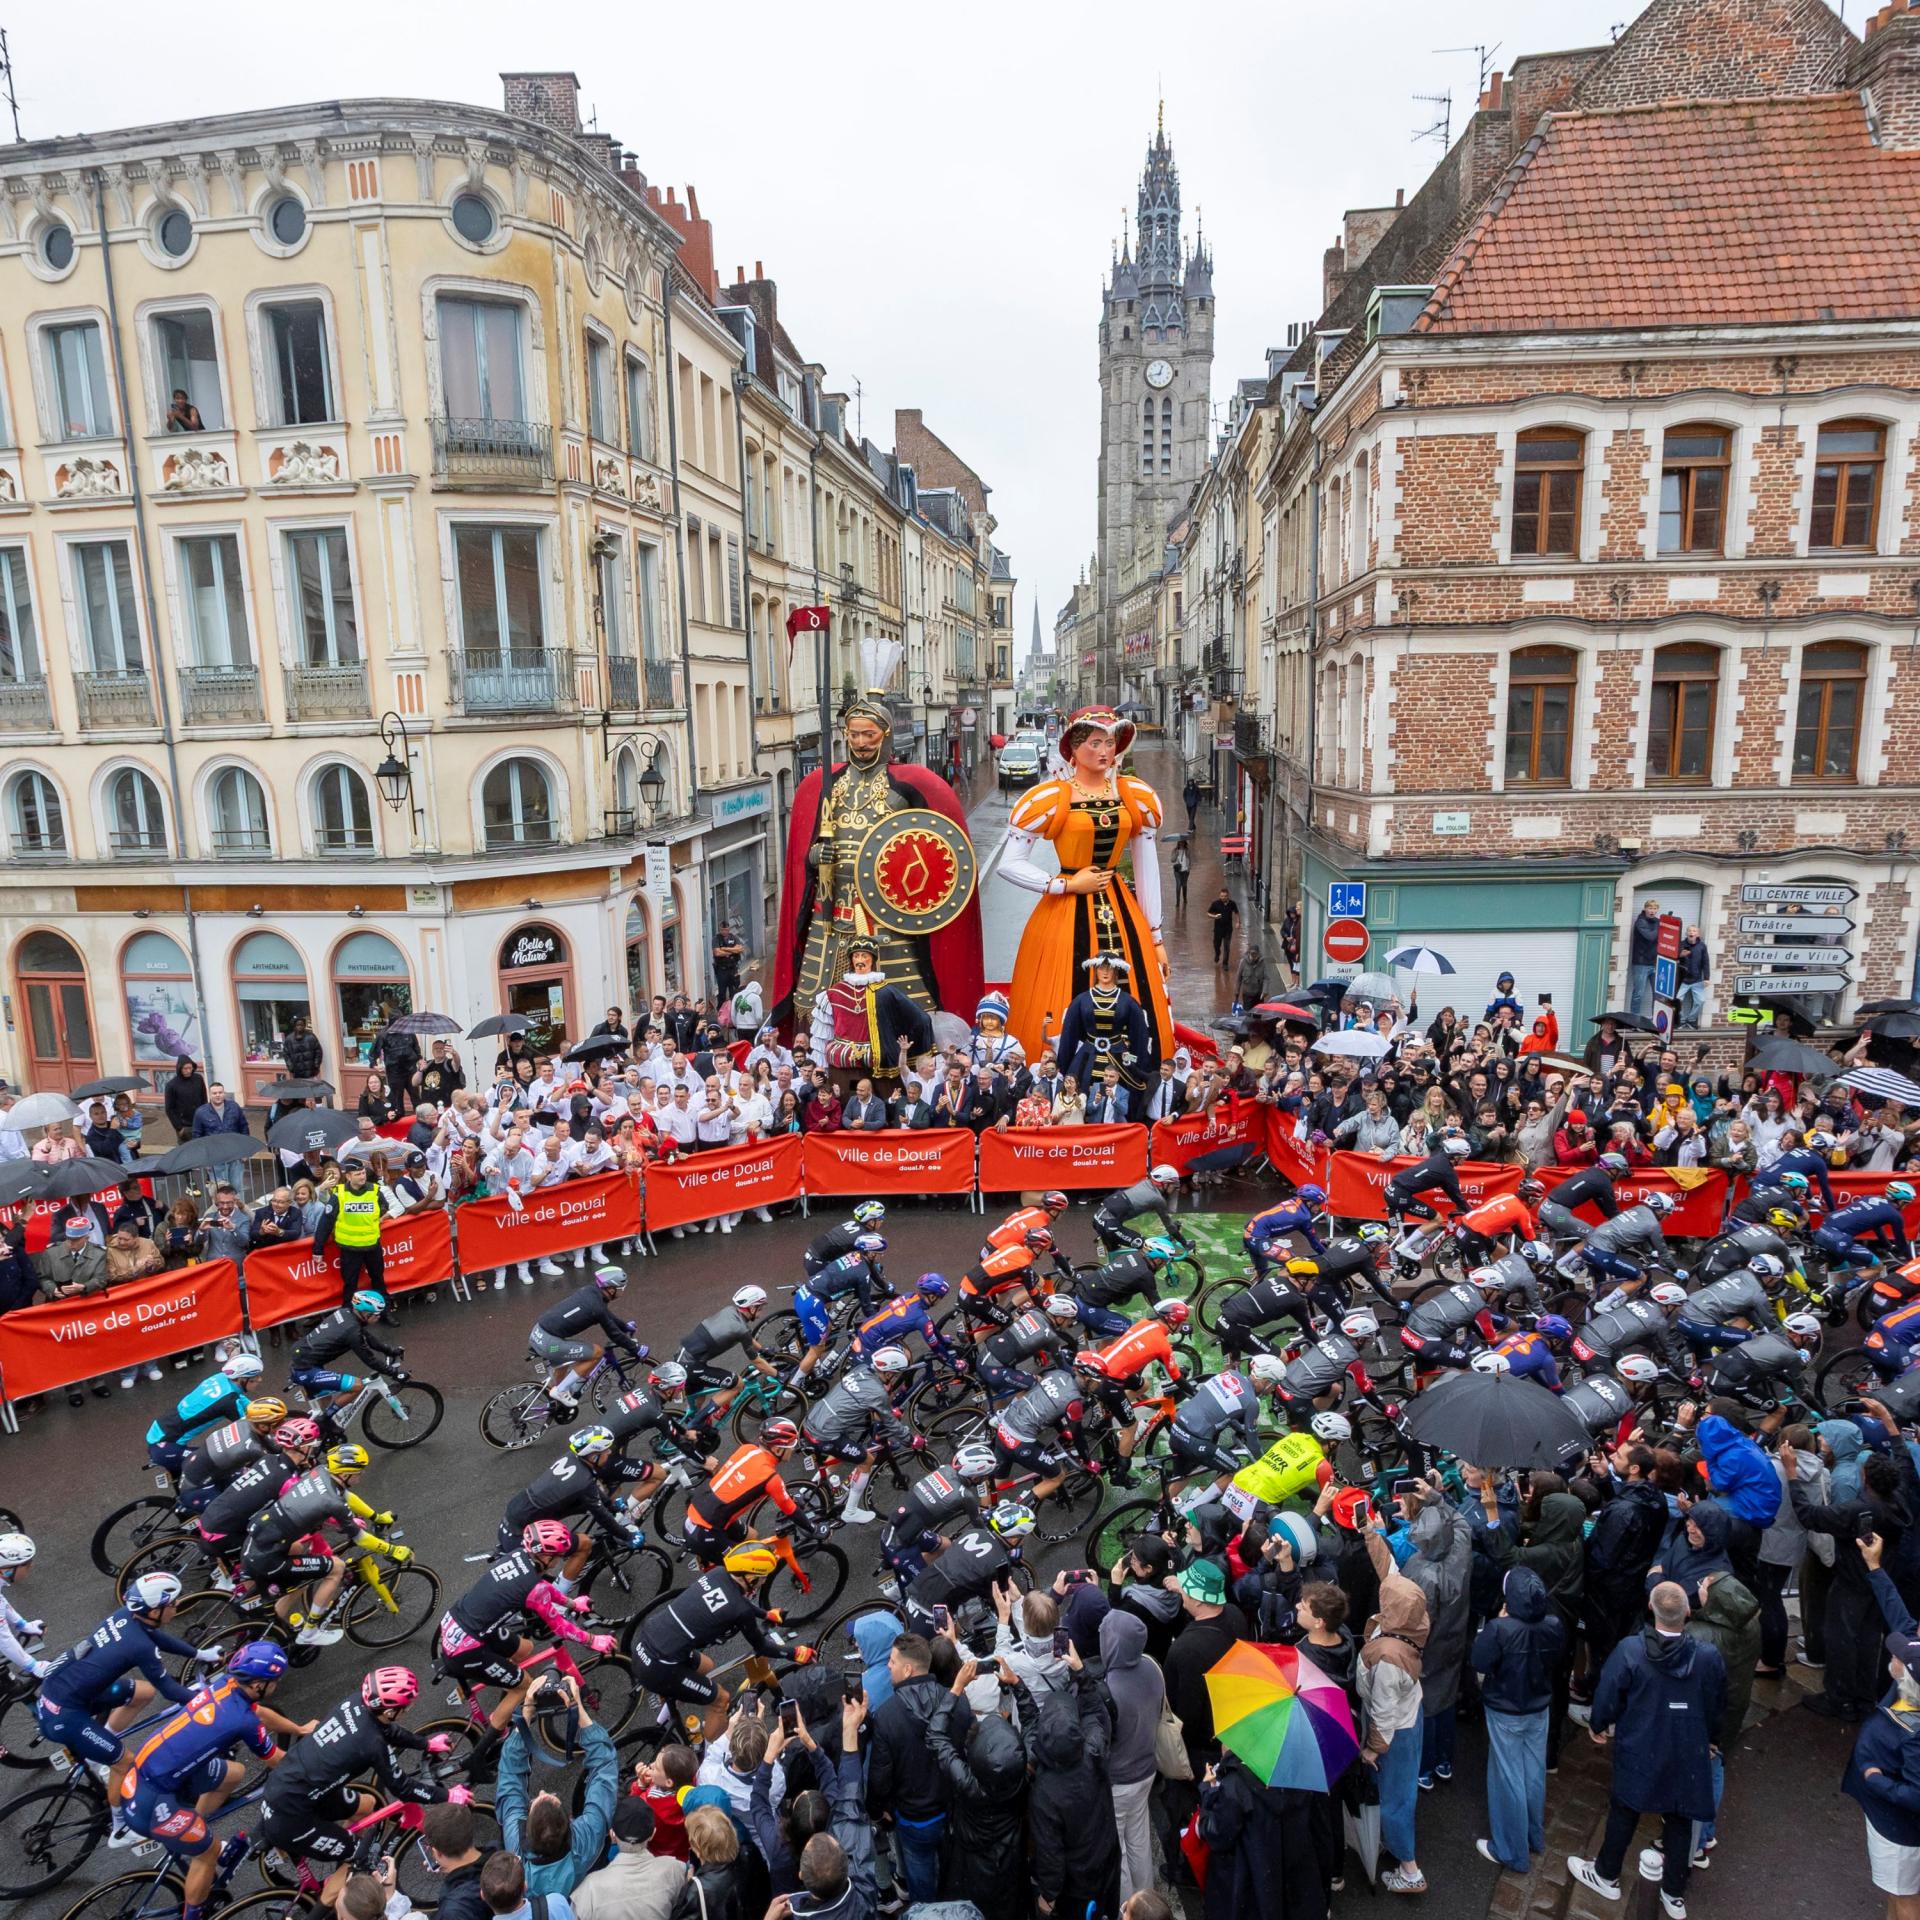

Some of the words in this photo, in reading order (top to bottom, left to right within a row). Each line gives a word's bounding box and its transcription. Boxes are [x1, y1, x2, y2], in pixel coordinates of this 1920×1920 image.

[1766, 889, 1811, 900] CENTRE
[1815, 890, 1846, 901] VILLE
[1747, 920, 1793, 930] Théâtre
[518, 937, 545, 952] Belle
[512, 950, 548, 965] Nature
[1743, 950, 1778, 960] Hôtel
[1785, 951, 1800, 960] de
[1808, 952, 1839, 961] Ville
[1744, 981, 1753, 990] P
[1759, 980, 1809, 990] Parking
[1176, 1131, 1199, 1146] Ville
[1202, 1127, 1216, 1141] de
[837, 1148, 869, 1162] Ville
[873, 1148, 893, 1162] de
[897, 1144, 942, 1162] Douai
[1013, 1145, 1045, 1159] Ville
[1048, 1145, 1068, 1158] de
[1072, 1143, 1115, 1157] Douai
[899, 1164, 925, 1172] douai.fr
[1072, 1159, 1099, 1167] douai.fr
[678, 1172, 708, 1189] Ville
[711, 1168, 730, 1182] de
[733, 1156, 774, 1177] Douai
[1366, 1172, 1391, 1187] Vill
[735, 1176, 760, 1188] douai.fr
[1614, 1186, 1633, 1202] de
[35, 1199, 61, 1216] de
[345, 1203, 375, 1212] POLICE
[496, 1211, 530, 1229] Ville
[534, 1206, 556, 1222] de
[560, 1193, 606, 1216] Douai
[562, 1214, 590, 1226] douai.fr
[288, 1258, 328, 1281] Ville
[1449, 1285, 1470, 1303] lotto
[50, 1319, 97, 1343] Ville
[103, 1310, 131, 1330] de
[136, 1291, 197, 1322] Douai
[1626, 1301, 1649, 1318] lotto
[141, 1316, 177, 1333] douai.fr
[809, 1316, 826, 1332] BORA
[1317, 1340, 1338, 1359] lotto
[1449, 1347, 1466, 1359] lotto
[842, 1373, 860, 1392] lotto
[1041, 1377, 1060, 1399] lotto
[1588, 1380, 1616, 1401] lotto
[631, 1388, 649, 1406] UAE
[615, 1398, 630, 1415] XRG
[842, 1443, 861, 1457] lotto
[1038, 1450, 1056, 1466] lotto
[1422, 1450, 1433, 1475] ARKE
[622, 1465, 642, 1478] UAE
[302, 1557, 321, 1566] VISMA
[496, 1559, 520, 1581] EF
[484, 1662, 507, 1678] EF
[682, 1677, 700, 1692] REMA
[317, 1716, 348, 1744] EF
[82, 1727, 116, 1753] Groupama
[172, 1814, 191, 1827] PIC
[139, 1841, 160, 1854] 196
[310, 1835, 339, 1852] EF
